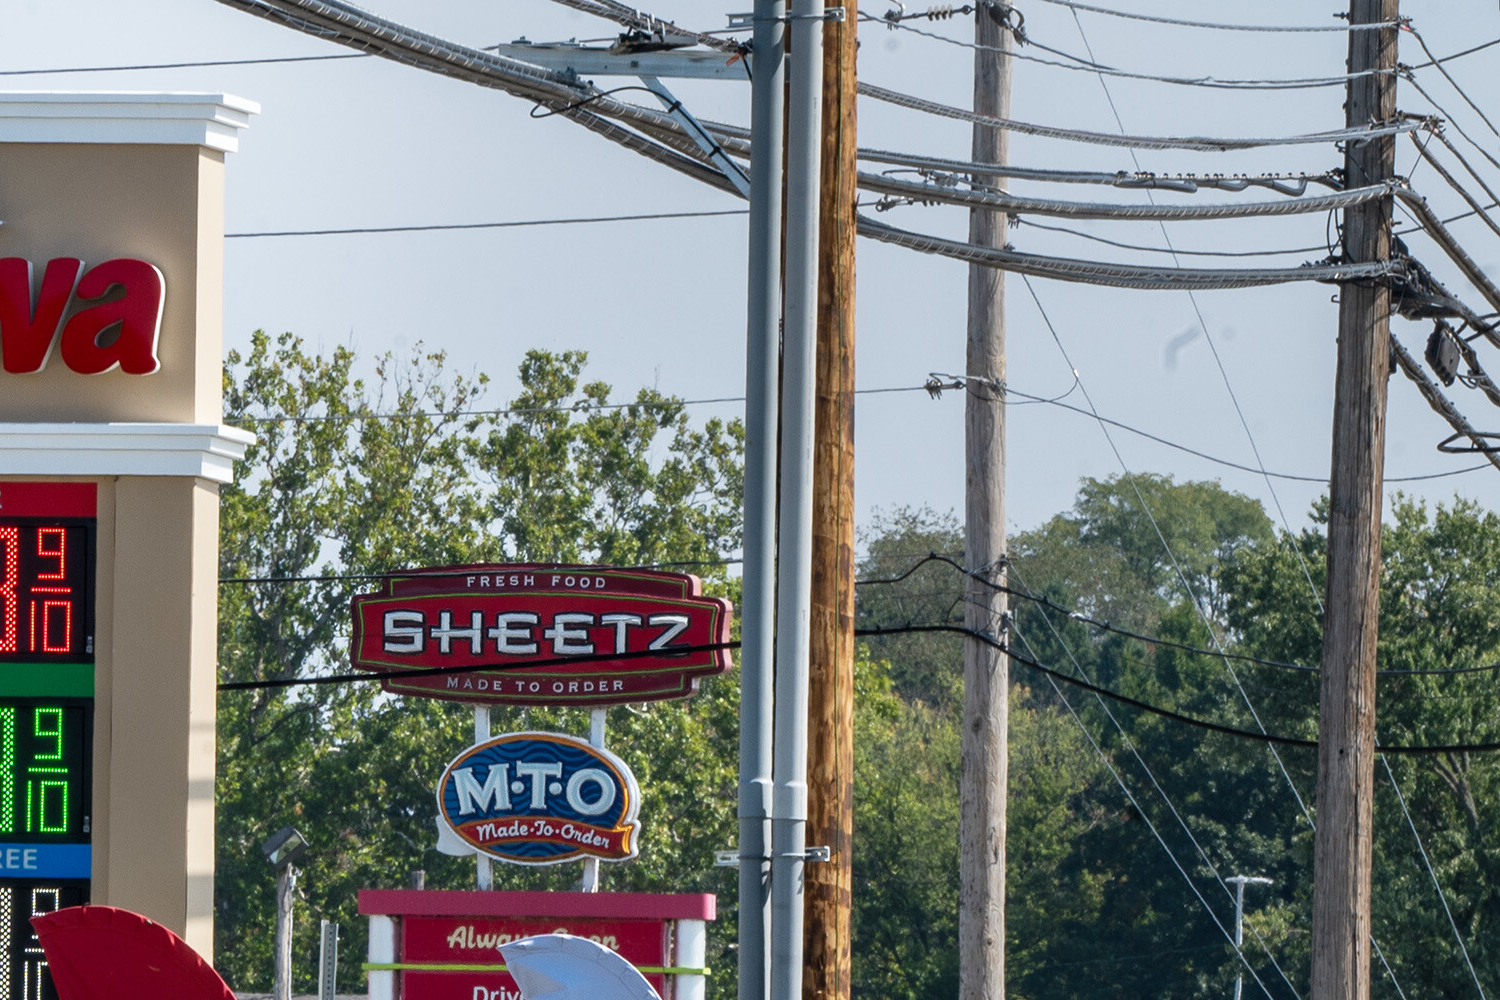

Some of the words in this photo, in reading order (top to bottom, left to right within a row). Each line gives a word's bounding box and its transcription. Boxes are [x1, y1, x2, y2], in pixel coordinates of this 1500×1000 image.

[466, 574, 536, 588] FRESH
[551, 575, 607, 589] FOOD
[382, 610, 692, 656] SHEETZ
[446, 676, 503, 691] MADE
[515, 681, 541, 693] TO
[553, 679, 625, 693] ORDER
[446, 925, 528, 950] Alwa
